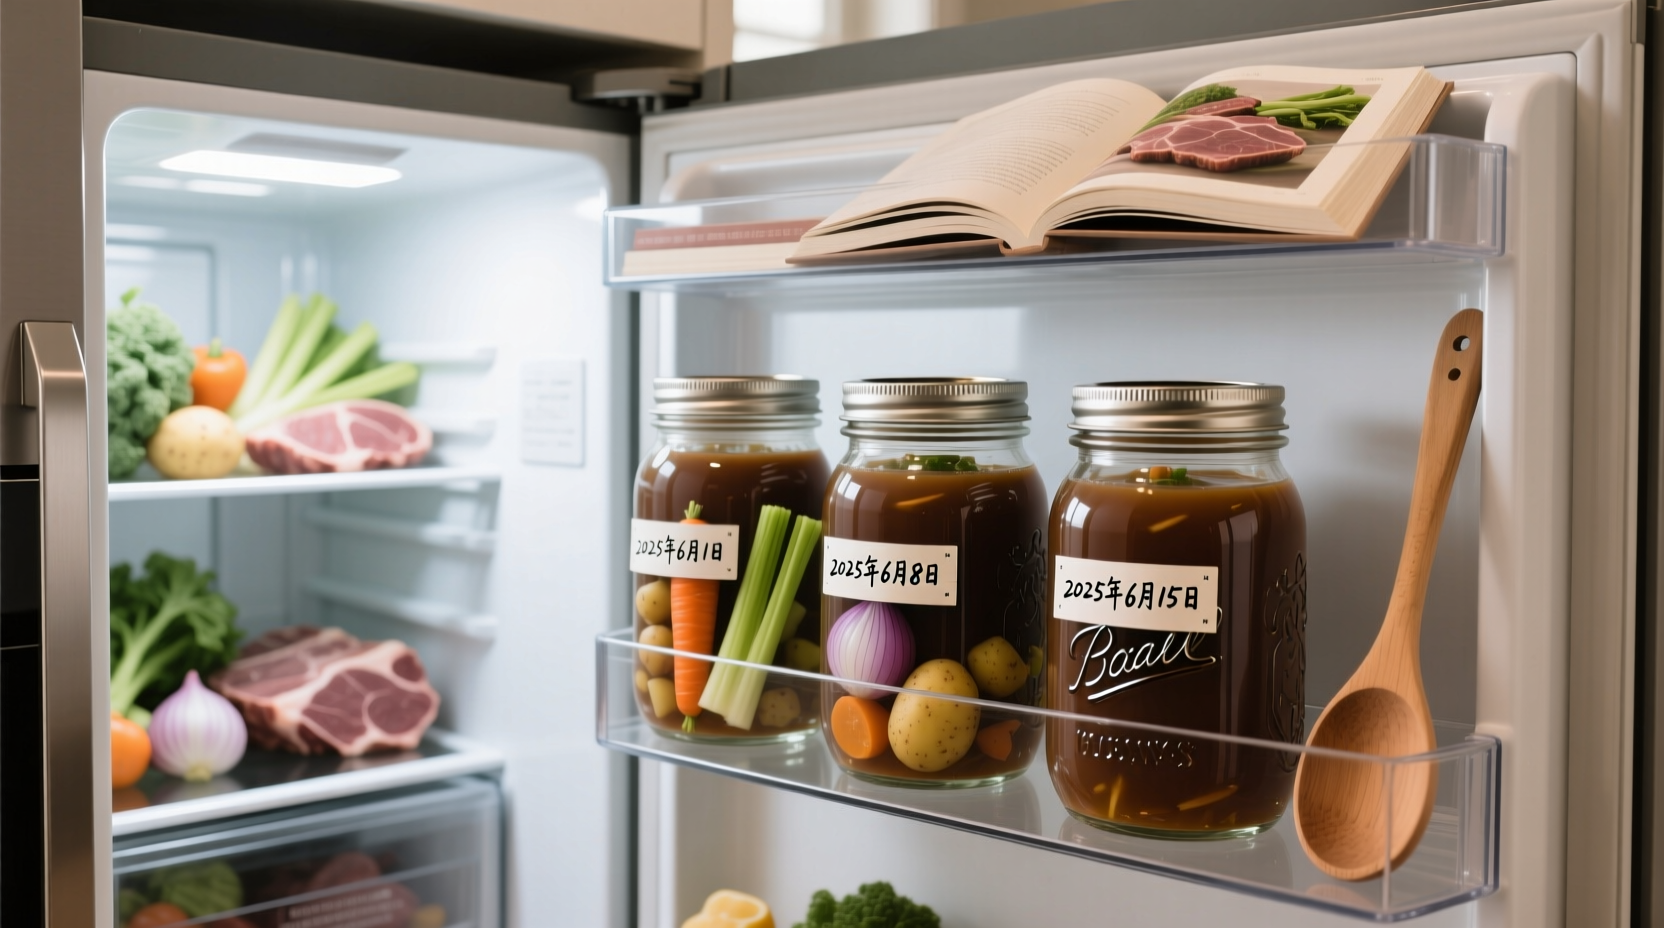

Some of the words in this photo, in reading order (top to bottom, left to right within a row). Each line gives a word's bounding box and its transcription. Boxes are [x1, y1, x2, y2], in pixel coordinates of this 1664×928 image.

[636, 534, 723, 565] 2025年6月1日
[829, 554, 939, 588] 2025年6月8日
[1063, 575, 1199, 611] 2025年6月15日
